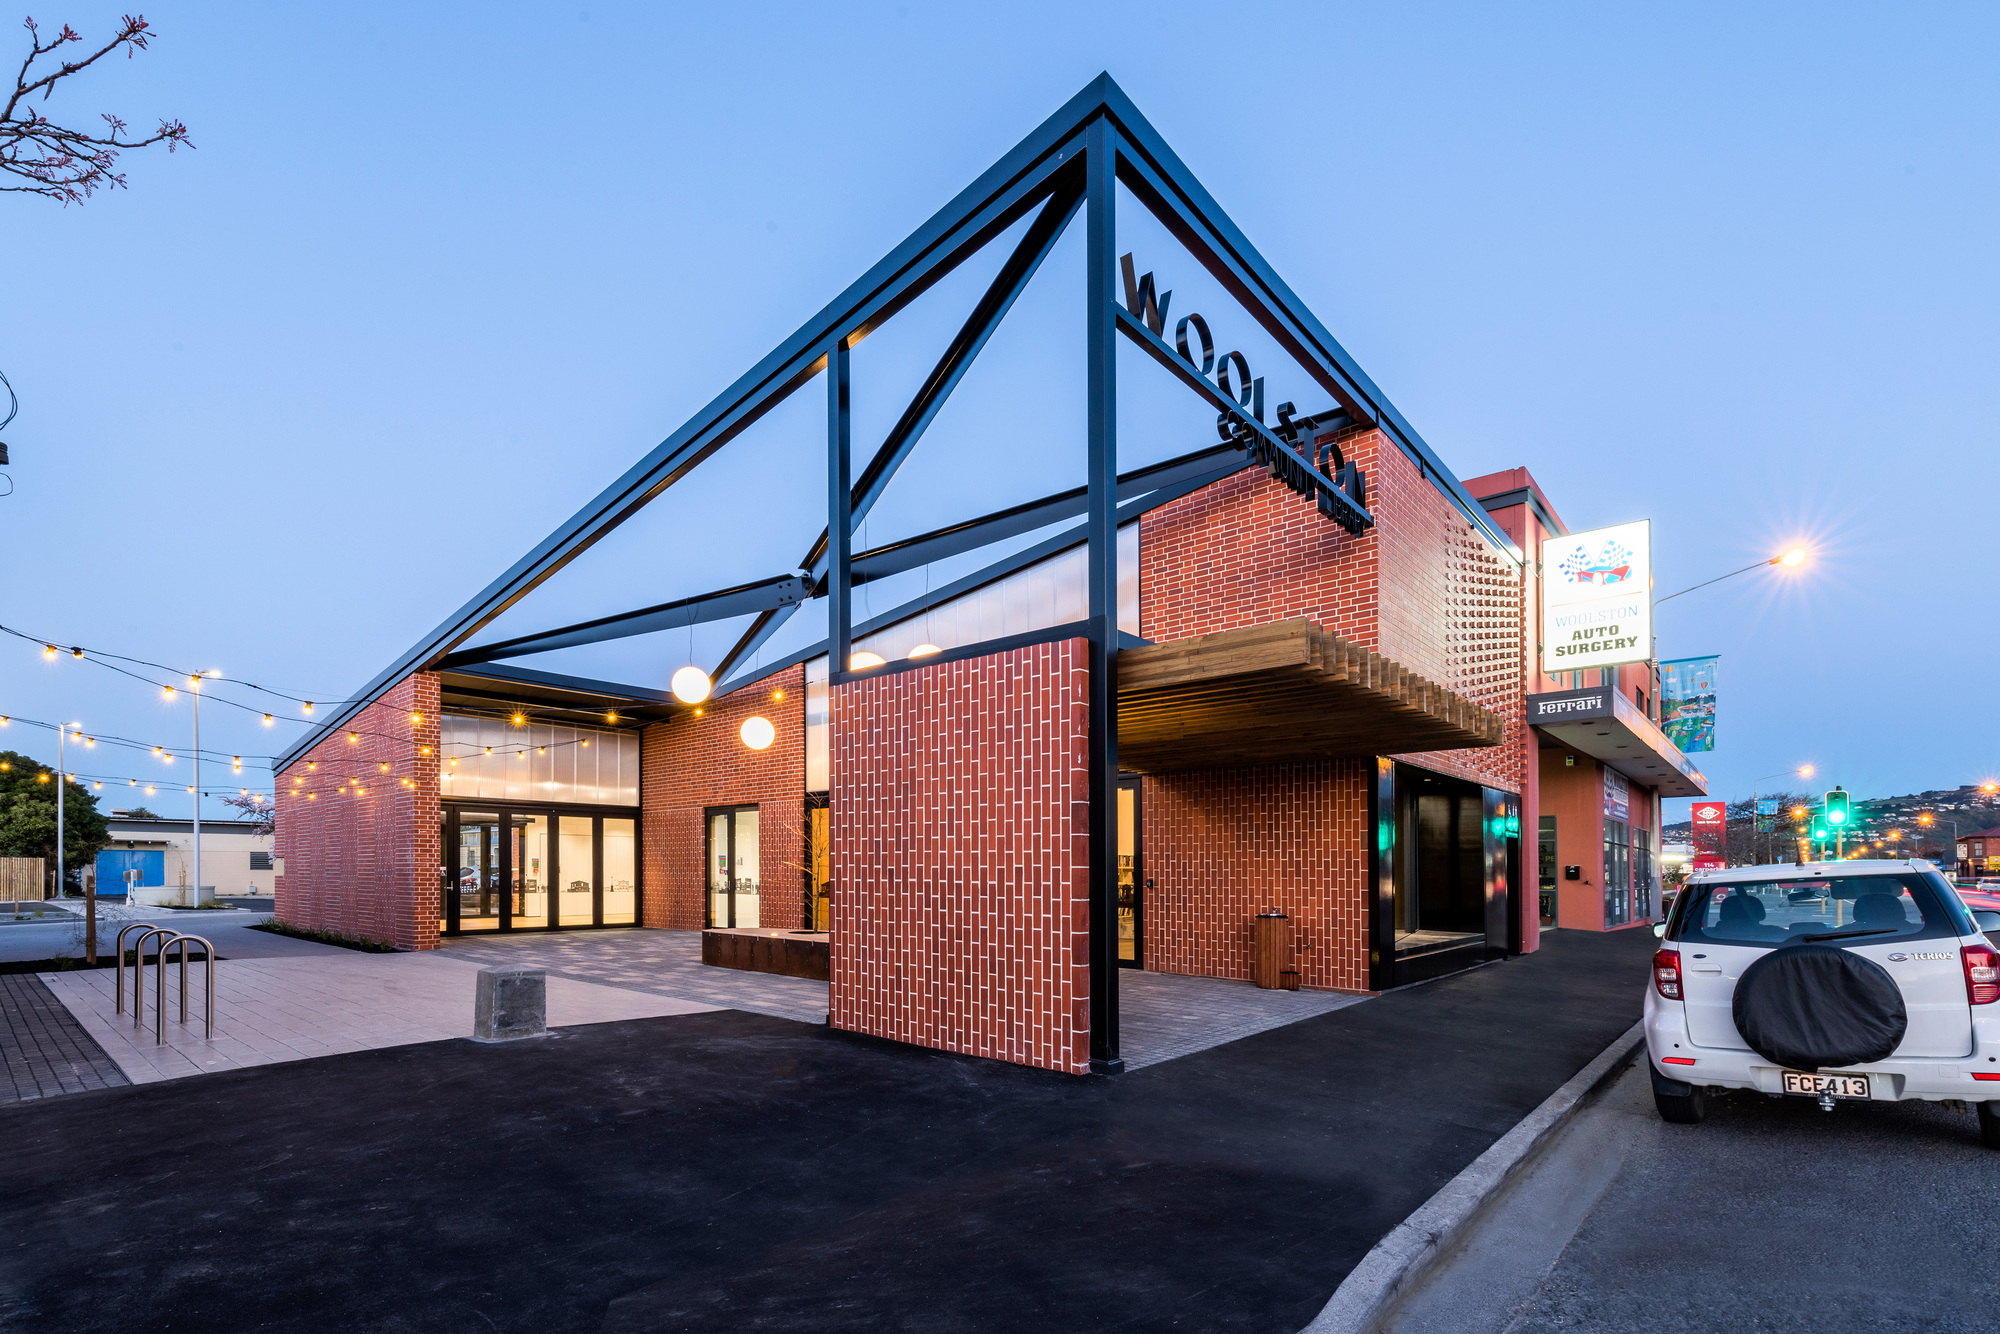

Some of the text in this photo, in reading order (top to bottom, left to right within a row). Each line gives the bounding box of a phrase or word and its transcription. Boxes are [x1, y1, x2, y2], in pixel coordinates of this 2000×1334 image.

[1120, 252, 1366, 505] WOOLSTON
[1556, 605, 1638, 627] WOOLSTON
[1572, 624, 1620, 641] AUTO
[1555, 636, 1638, 657] SURGERY
[1538, 695, 1602, 715] Ferrari
[1911, 952, 1955, 960] TERIOS
[1786, 1076, 1866, 1095] FCE413
